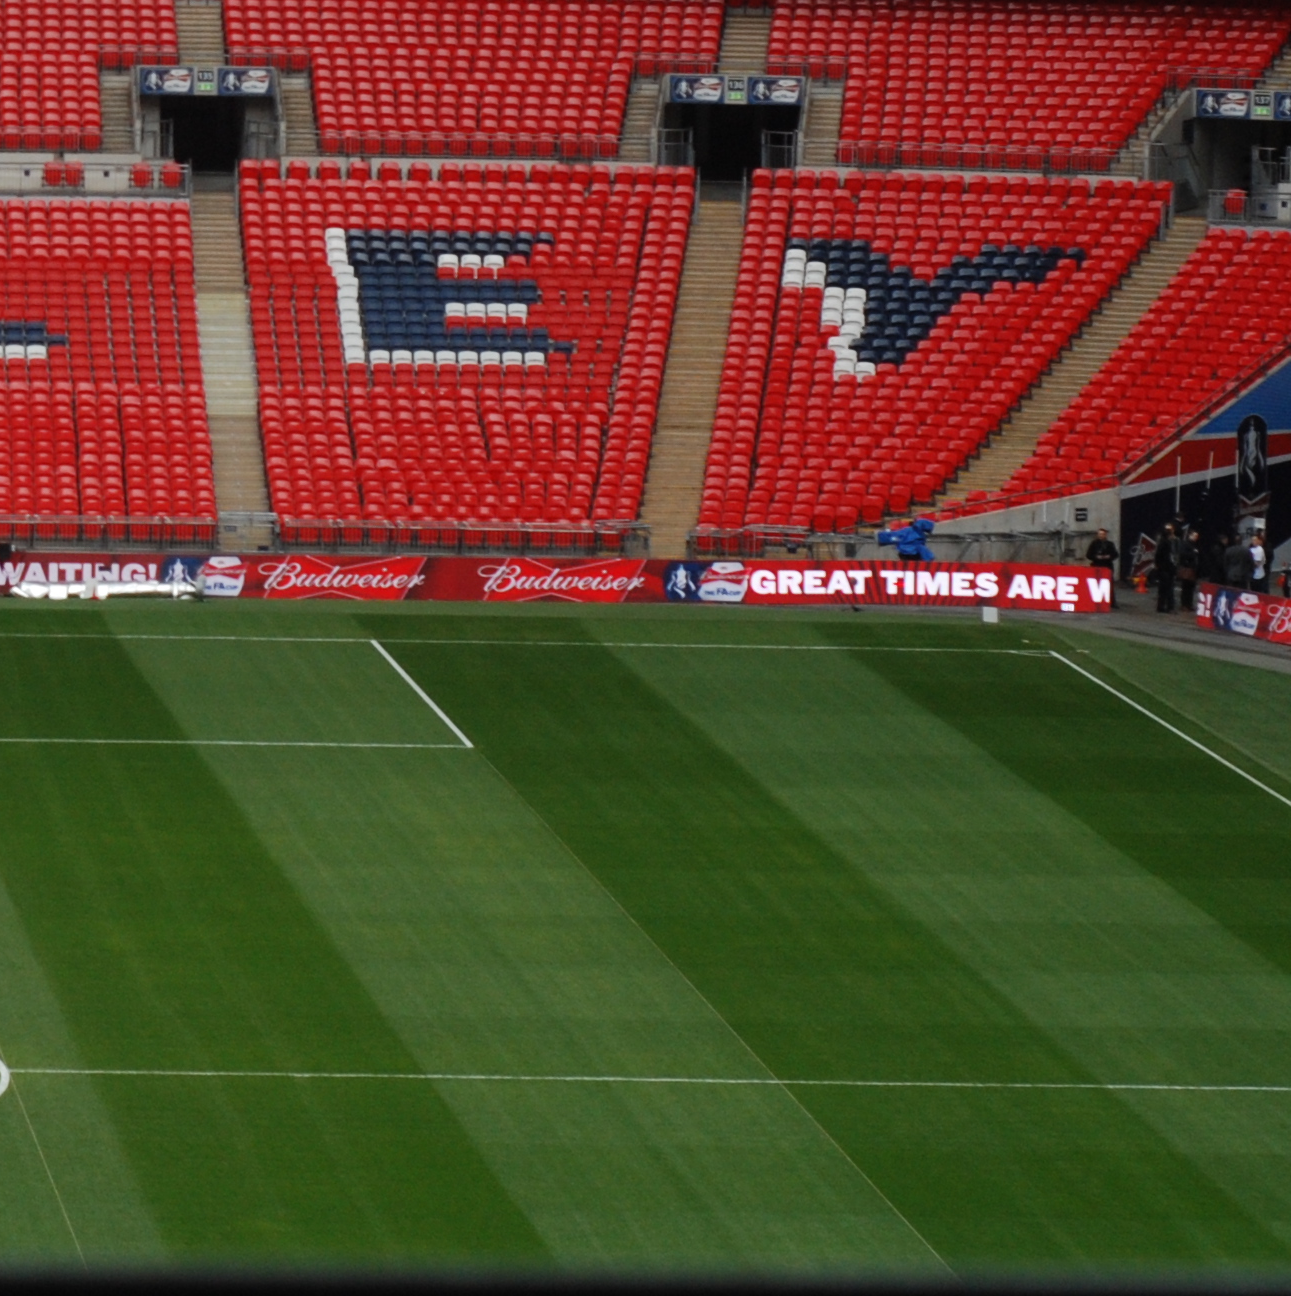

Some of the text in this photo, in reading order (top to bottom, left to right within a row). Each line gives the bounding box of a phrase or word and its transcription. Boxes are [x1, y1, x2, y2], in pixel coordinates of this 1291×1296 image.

[258, 560, 425, 591] Budweiser
[478, 561, 645, 592] Budweiser
[750, 569, 873, 596] GREAT
[881, 570, 999, 598] TIMES
[1007, 574, 1079, 601] ARE
[716, 588, 728, 596] FA
